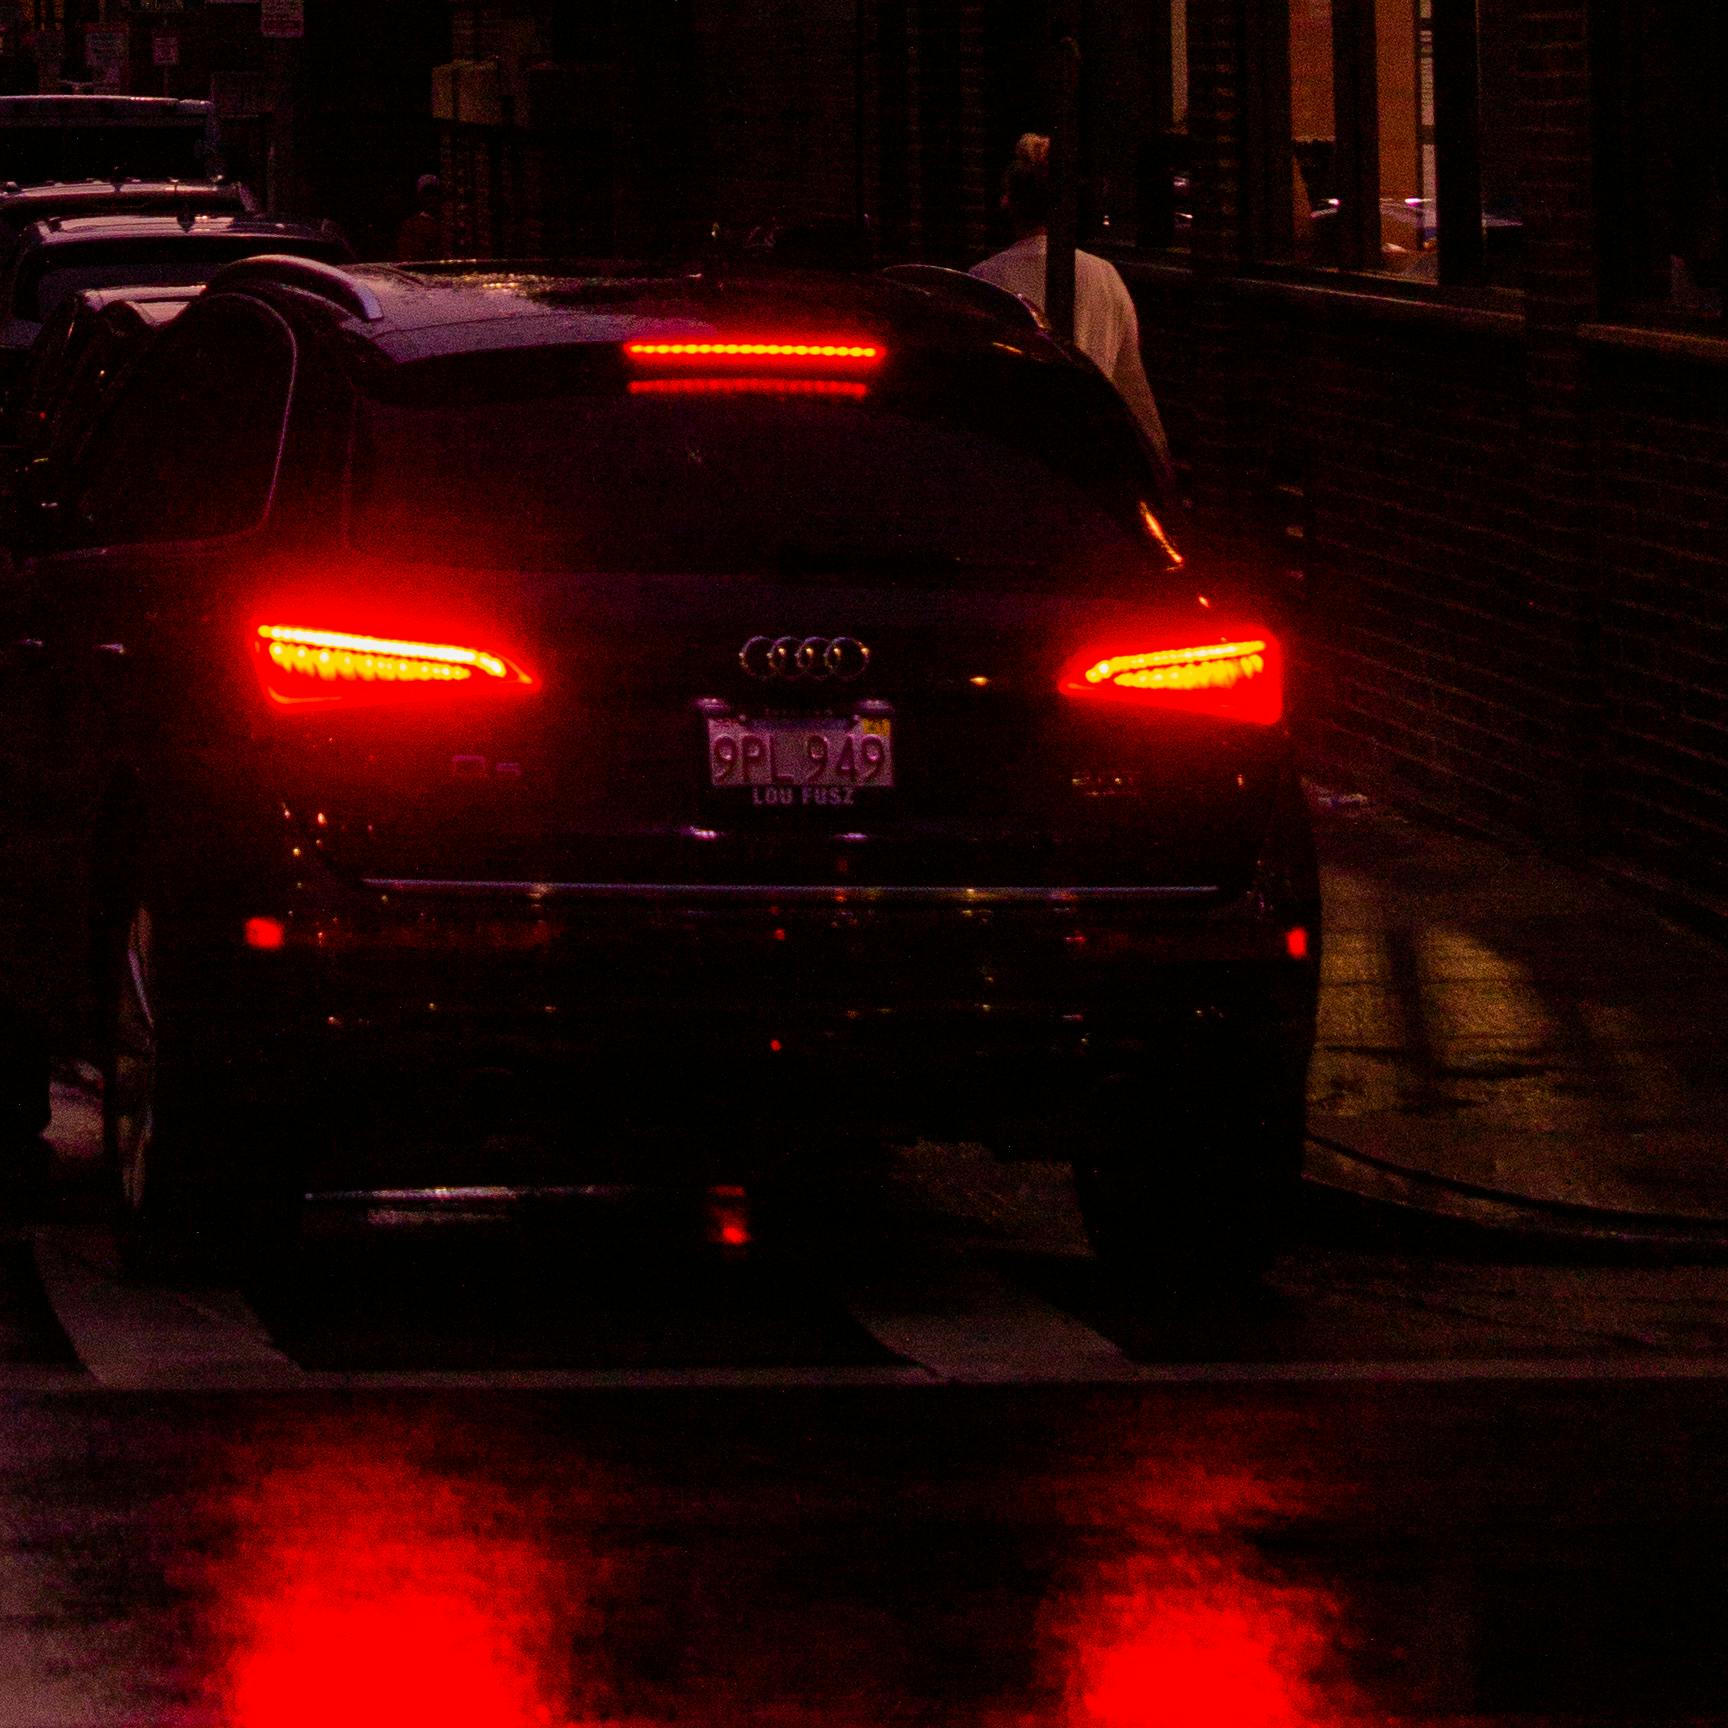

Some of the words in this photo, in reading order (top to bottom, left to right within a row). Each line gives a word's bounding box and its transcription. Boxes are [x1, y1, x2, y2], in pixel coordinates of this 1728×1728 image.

[713, 735, 795, 784] 9PL
[804, 734, 885, 784] 949
[752, 787, 794, 805] LOU
[801, 787, 855, 805] FUSZ
